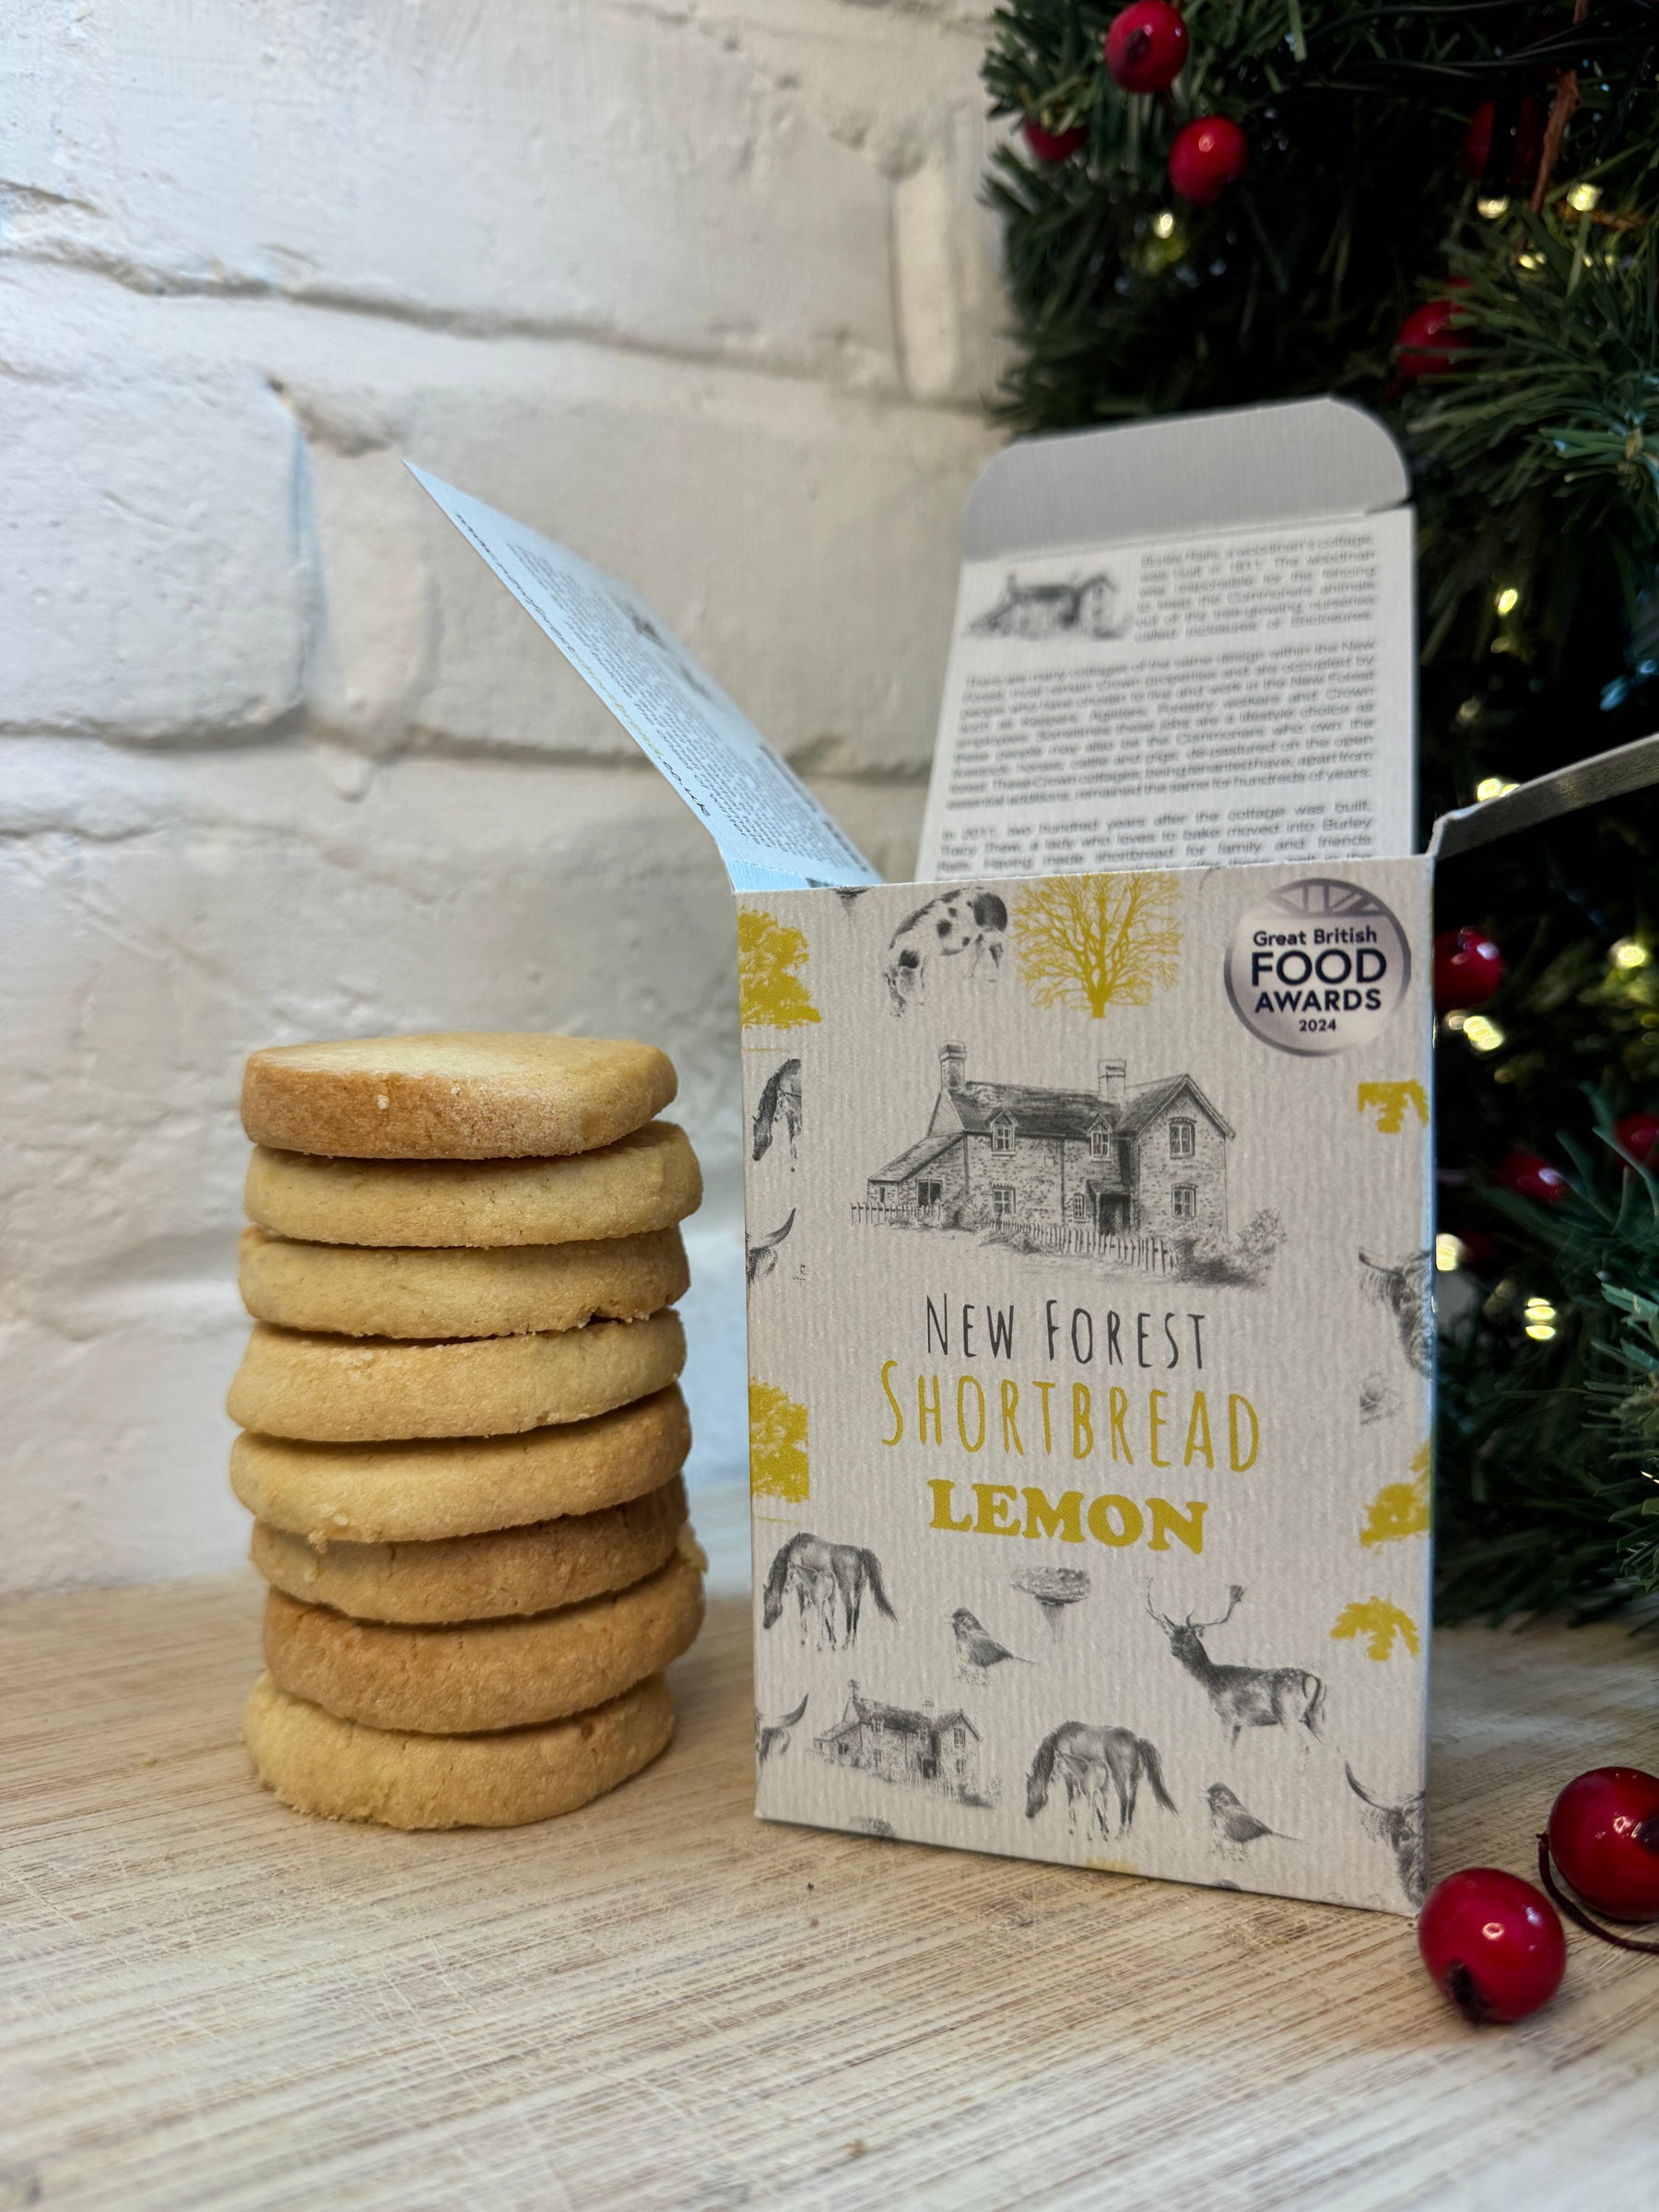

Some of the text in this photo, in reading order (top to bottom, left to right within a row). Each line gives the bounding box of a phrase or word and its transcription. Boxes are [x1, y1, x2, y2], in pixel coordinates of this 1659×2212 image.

[1253, 925, 1377, 947] Great British
[1252, 947, 1387, 987] FOOD
[1254, 989, 1382, 1013] AWARDS
[1299, 1018, 1336, 1032] 2024
[927, 1478, 1209, 1555] LEMON
